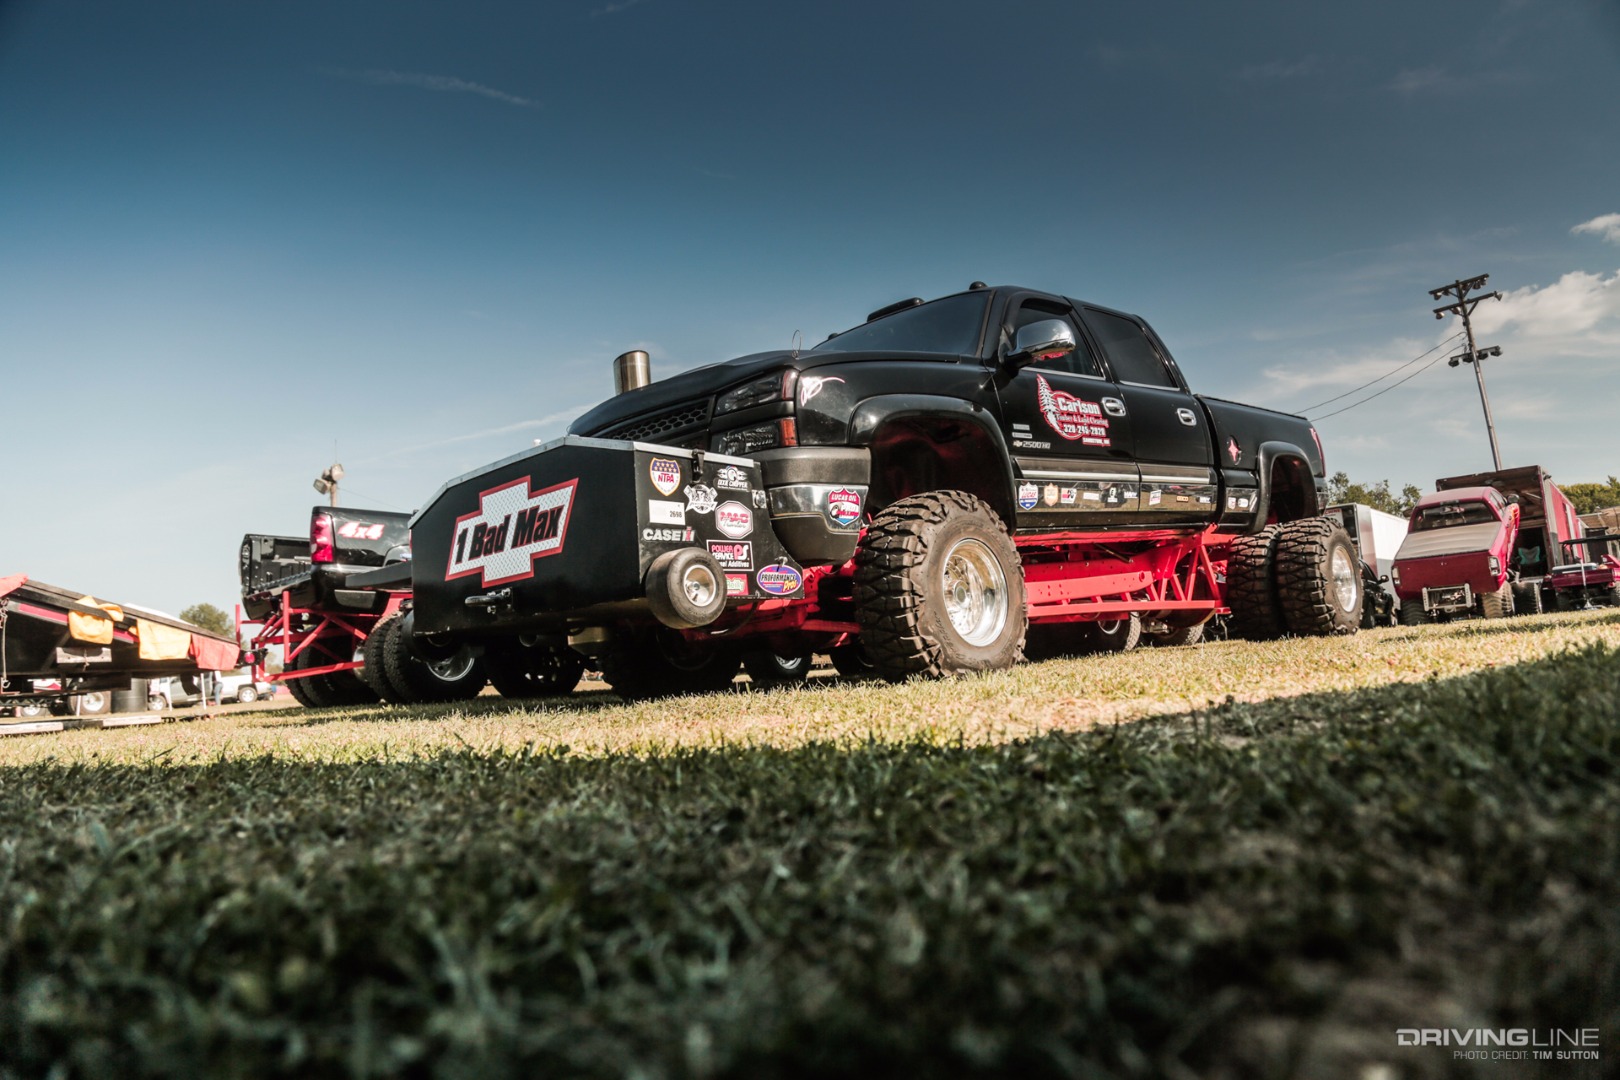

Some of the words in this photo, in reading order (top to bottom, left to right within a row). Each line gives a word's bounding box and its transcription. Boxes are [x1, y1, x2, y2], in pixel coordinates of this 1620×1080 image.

[1057, 397, 1101, 415] Carlson
[657, 472, 675, 483] NTPA
[338, 521, 385, 540] 4x4
[455, 527, 468, 565] 1
[468, 514, 511, 561] Bad
[511, 505, 565, 550] Max
[643, 528, 682, 541] CASE
[711, 544, 733, 553] POWER
[728, 560, 750, 568] Additives
